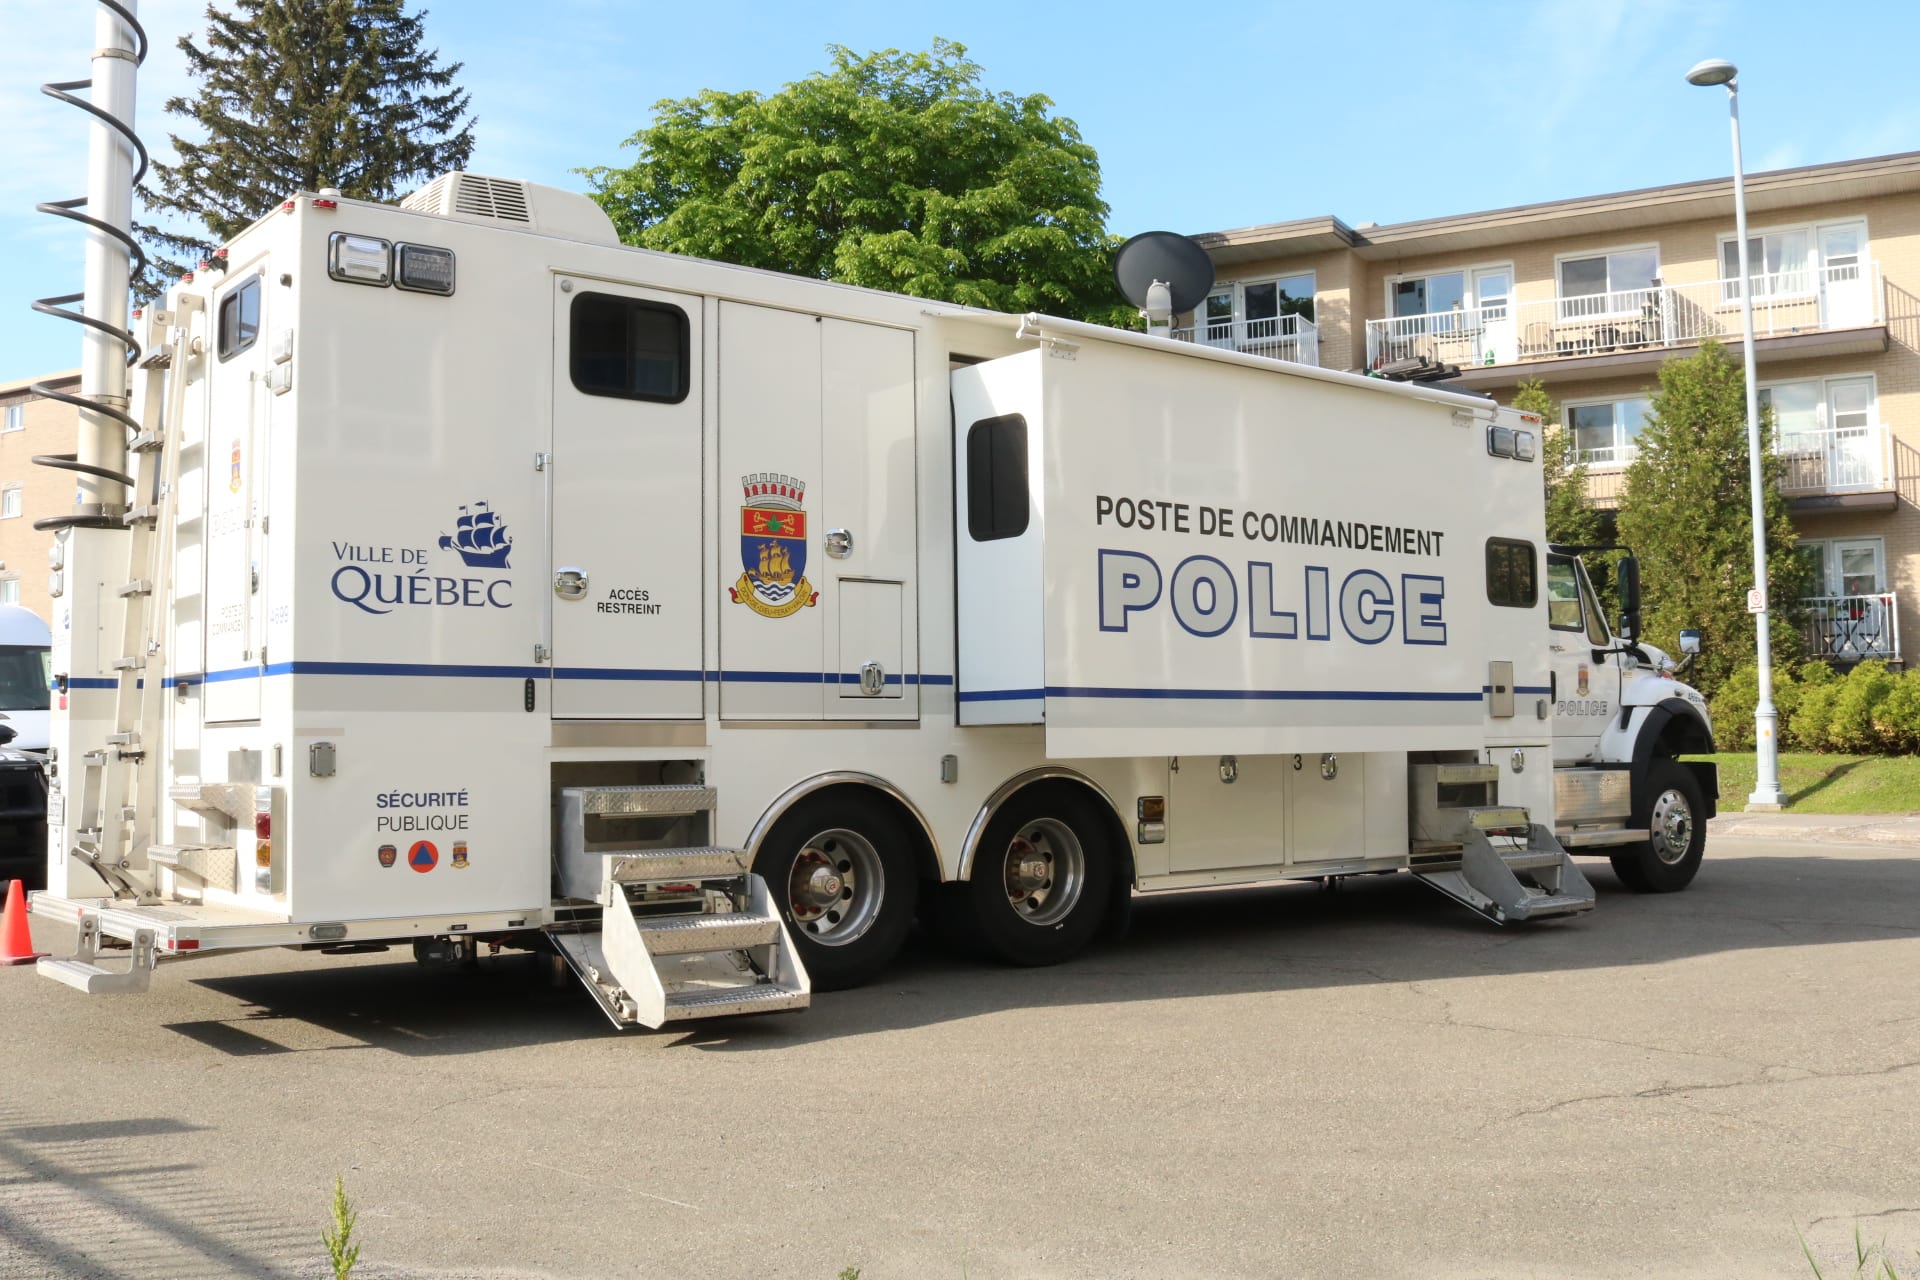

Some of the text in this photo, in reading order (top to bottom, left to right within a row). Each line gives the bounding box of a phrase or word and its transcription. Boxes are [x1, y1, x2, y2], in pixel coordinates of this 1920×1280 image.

[1096, 495, 1444, 557] POSTE DE COMMANDEMENT
[332, 541, 428, 564] VILLE DE
[331, 565, 512, 615] QUÉBEC
[609, 586, 649, 601] ACCÈS
[1098, 548, 1447, 646] POLICE
[597, 602, 662, 615] RESTREINT
[1556, 700, 1608, 716] POLICE
[1170, 756, 1180, 774] 4
[1293, 754, 1303, 771] 3
[376, 787, 469, 808] SÉCURITÉ
[377, 814, 469, 832] PUBLIQUE
